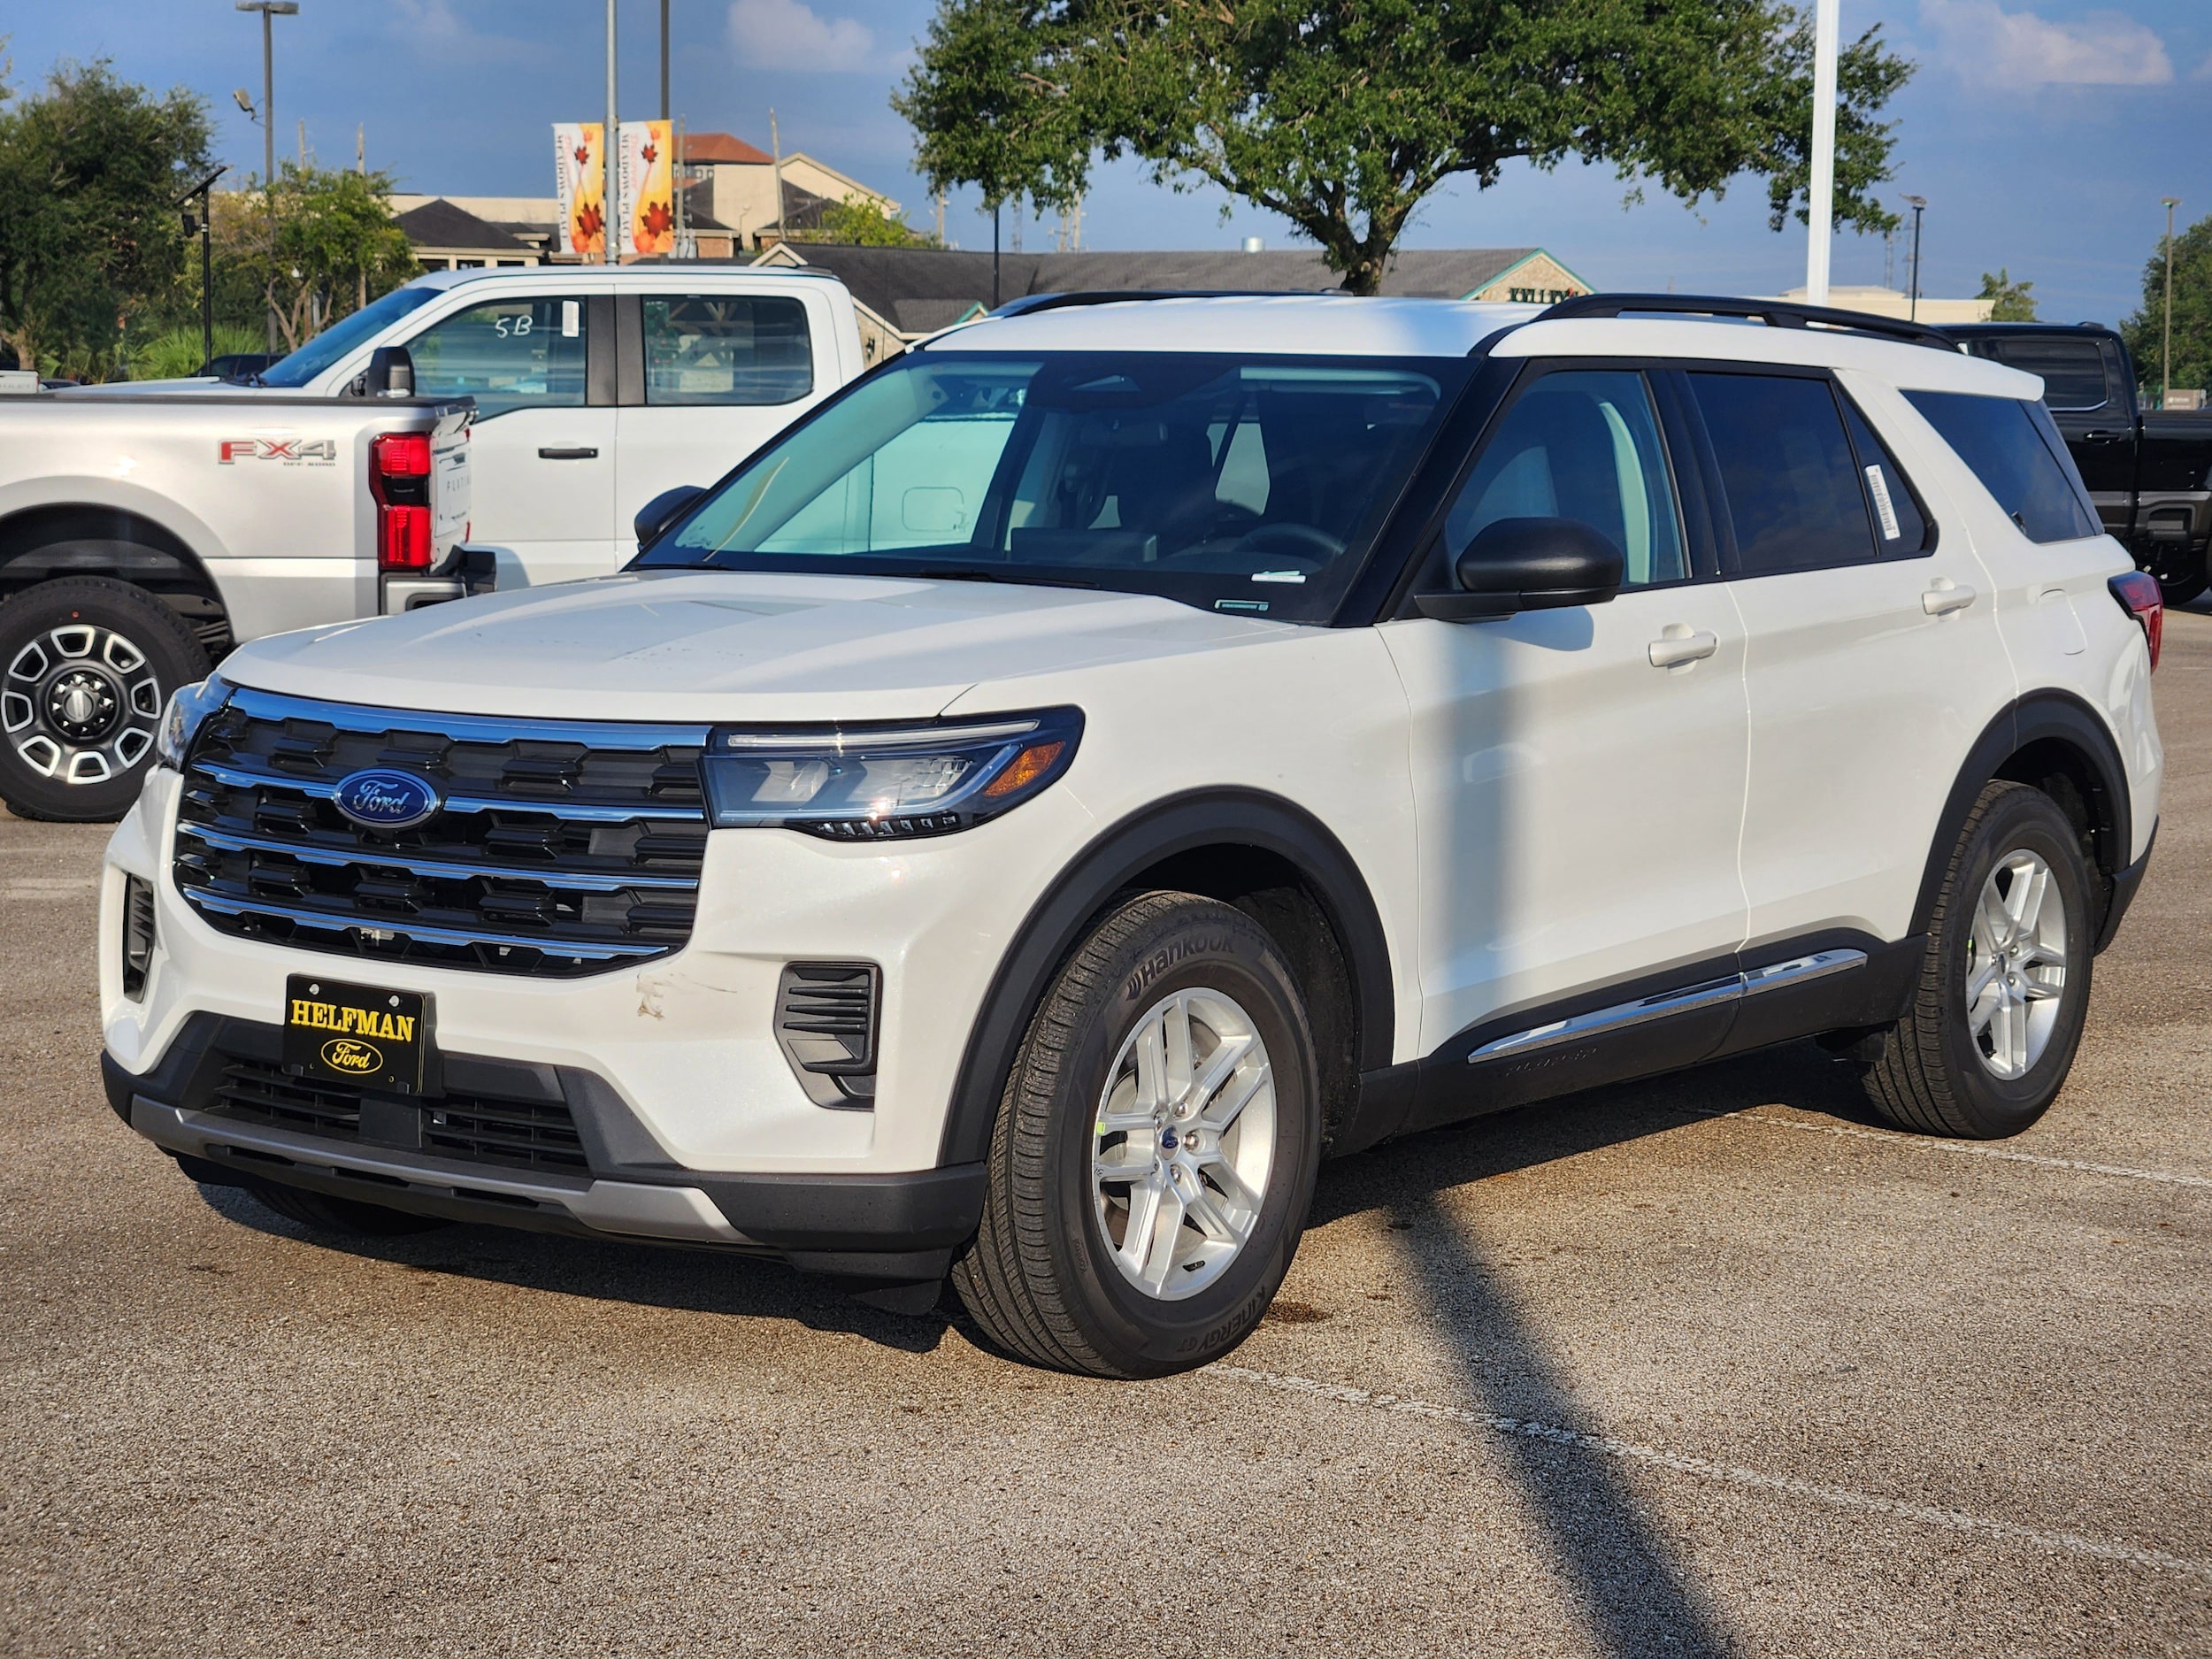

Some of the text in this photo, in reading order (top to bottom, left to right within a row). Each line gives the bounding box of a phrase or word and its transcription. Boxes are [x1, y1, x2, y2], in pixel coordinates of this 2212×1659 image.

[557, 134, 569, 241] MEADOWS PLACE
[621, 134, 631, 243] MEADOWS PLACE
[219, 439, 336, 465] FX4
[353, 780, 411, 814] Ford
[1141, 933, 1235, 986] Hankook
[290, 999, 416, 1042] HELFMAN
[331, 1041, 372, 1069] Ford
[1196, 1285, 1268, 1353] KINERGY
